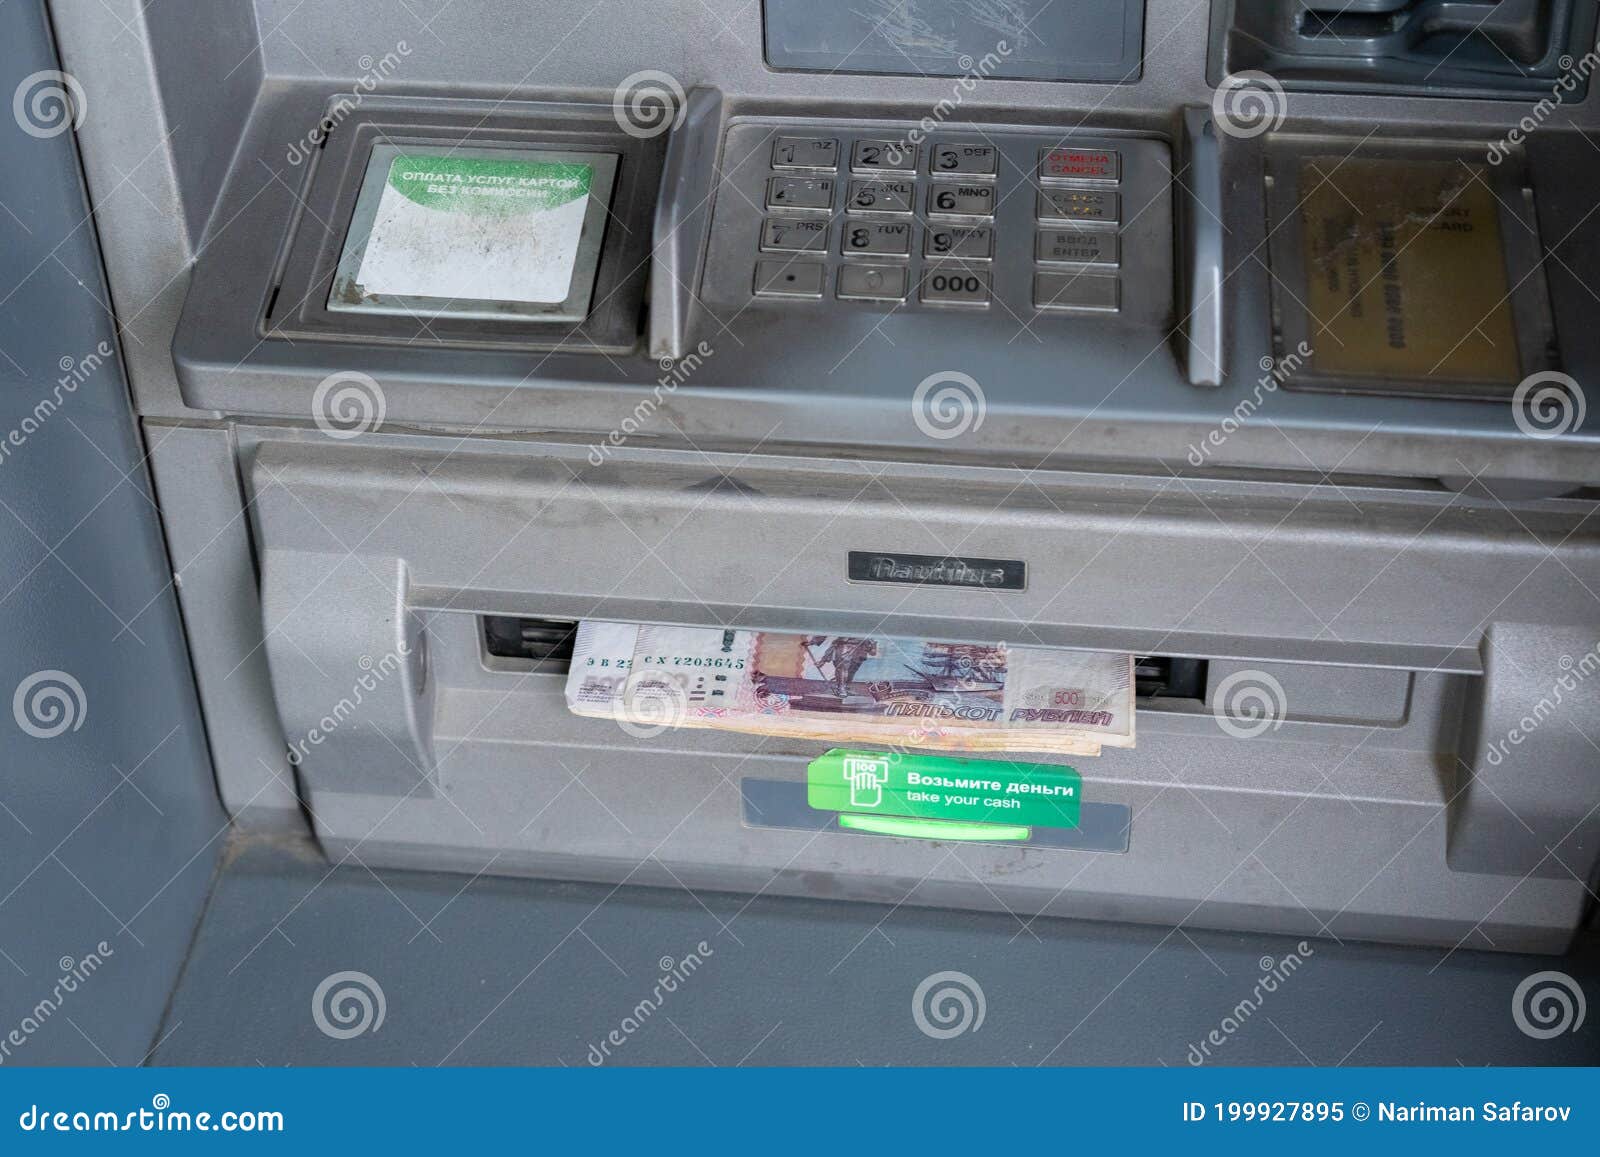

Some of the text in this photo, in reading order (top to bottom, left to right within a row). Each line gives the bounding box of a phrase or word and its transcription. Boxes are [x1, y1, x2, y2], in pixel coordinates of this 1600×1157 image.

[862, 147, 880, 164] 2
[940, 148, 991, 169] 3 DEF
[402, 172, 462, 182] ОПЛАТА
[427, 184, 457, 194] БЕЗ
[856, 187, 875, 206] 5
[937, 188, 990, 209] 6 MNO
[772, 222, 823, 244] 7 PRS
[851, 228, 869, 247] 8
[934, 233, 952, 252] 9
[932, 275, 980, 293] 000
[674, 656, 745, 670] 7203645
[1055, 691, 1079, 705] 500
[906, 772, 1075, 797] Возьмите деньги
[906, 789, 1021, 809] take your cash
